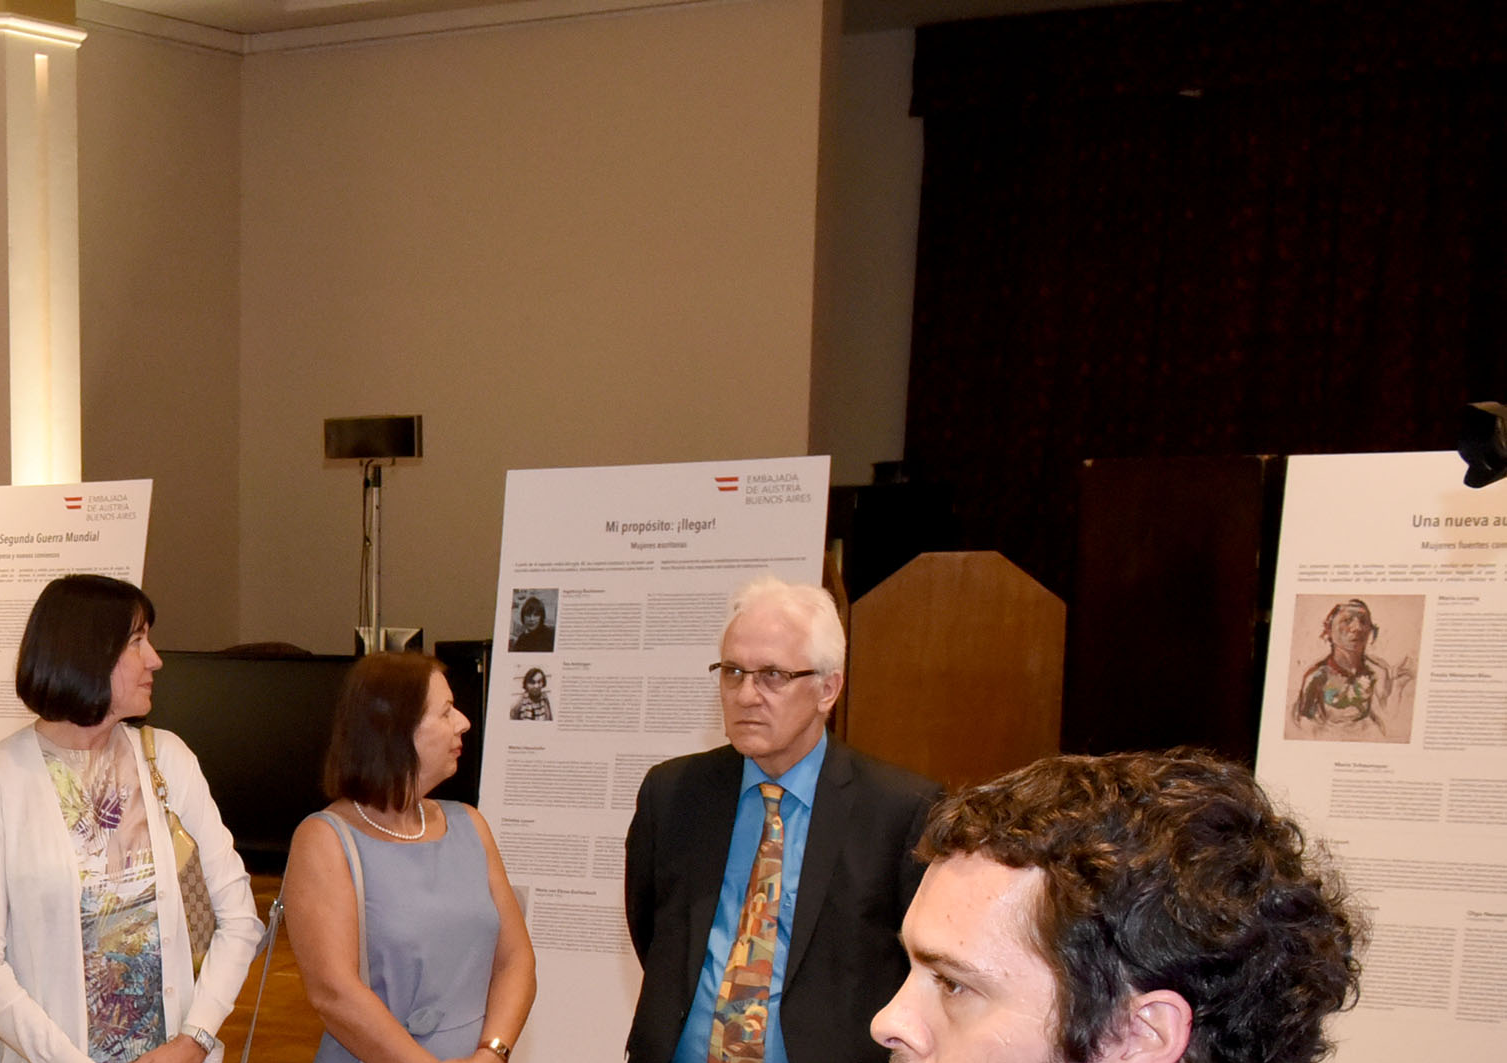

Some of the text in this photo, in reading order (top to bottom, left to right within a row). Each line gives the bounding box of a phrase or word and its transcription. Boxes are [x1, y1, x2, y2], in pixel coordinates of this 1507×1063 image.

[746, 473, 799, 484] EMBAJADA
[745, 484, 802, 494] DE AUSTRIA
[88, 494, 128, 503] EMBAJADA
[745, 494, 811, 505] BUENOS AIRES
[86, 503, 130, 513] DE AUSTRIA
[85, 512, 137, 522] BUENOS AIRES
[1412, 514, 1440, 528] Una
[1444, 516, 1489, 527] nueva
[605, 518, 717, 535] Mi propósito: ¡llegar!
[0, 532, 35, 547] Segunda
[36, 533, 63, 543] Guerra
[65, 530, 100, 542] Mundial
